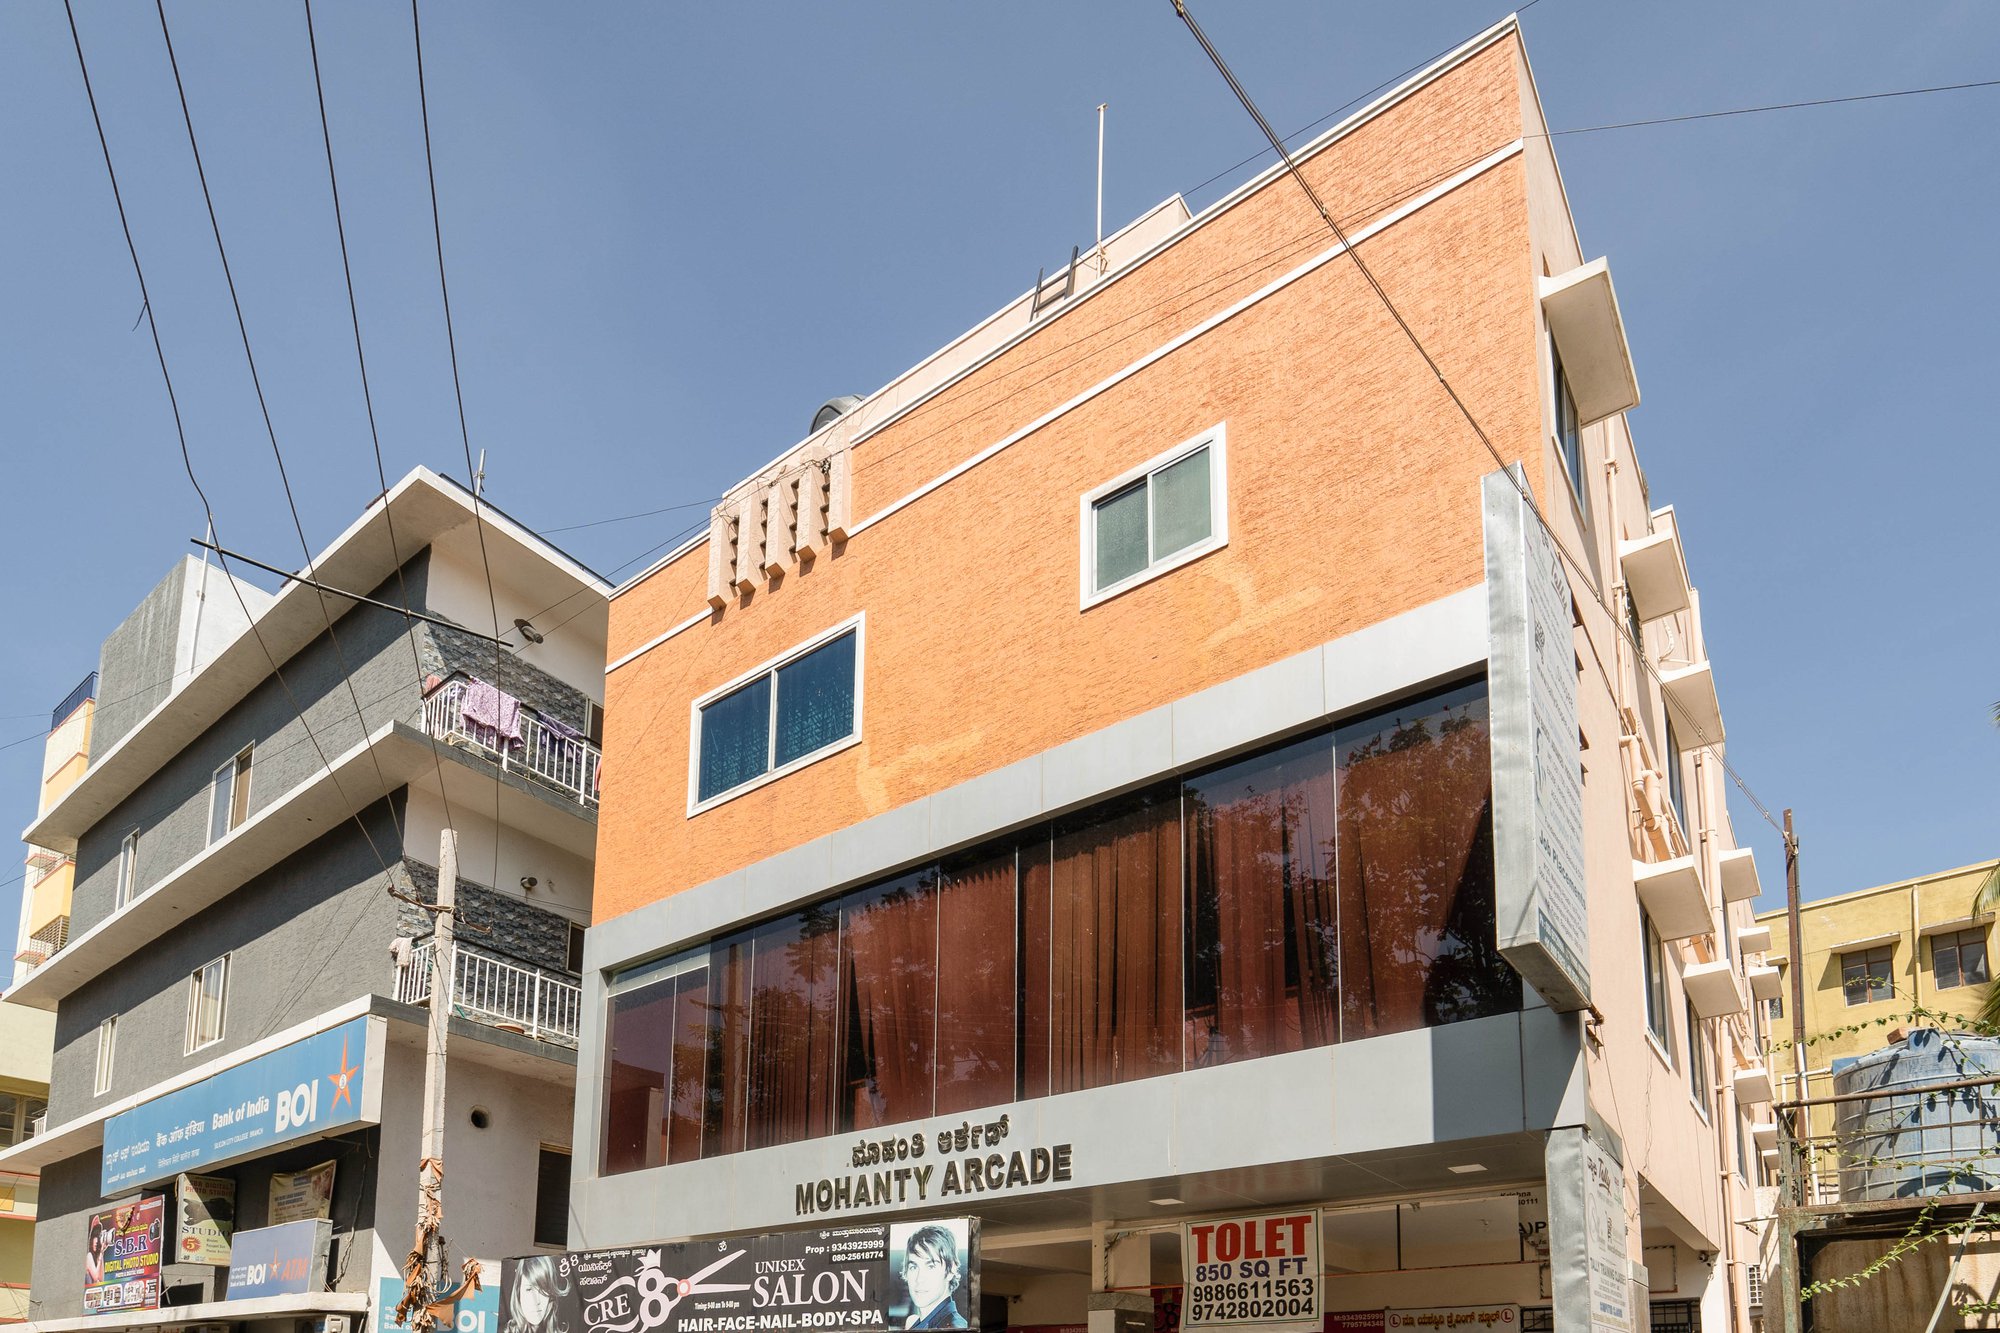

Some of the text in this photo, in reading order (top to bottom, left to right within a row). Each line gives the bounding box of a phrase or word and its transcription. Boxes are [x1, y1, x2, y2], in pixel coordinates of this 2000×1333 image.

[212, 1096, 270, 1131] Bank of India
[275, 1079, 319, 1133] BOI
[795, 1143, 1073, 1216] MOHANTY ARCADE
[181, 1226, 230, 1237] STUDIO
[1191, 1215, 1312, 1264] TOLET
[805, 1245, 825, 1255] Prop
[831, 1240, 885, 1252] 9343925999
[832, 1251, 885, 1262] 080-25618774
[104, 1252, 159, 1273] DIGITAL PHOTO STUDIO
[247, 1263, 267, 1286] BOI
[754, 1258, 806, 1274] UNISEX
[1196, 1257, 1308, 1283] 850 SQ FT
[752, 1269, 870, 1308] SALON
[1193, 1278, 1314, 1303] 9886611563
[678, 1310, 884, 1332] HAIR-FACE-NAIL-BODY-SPA
[1192, 1297, 1314, 1321] 9742802004
